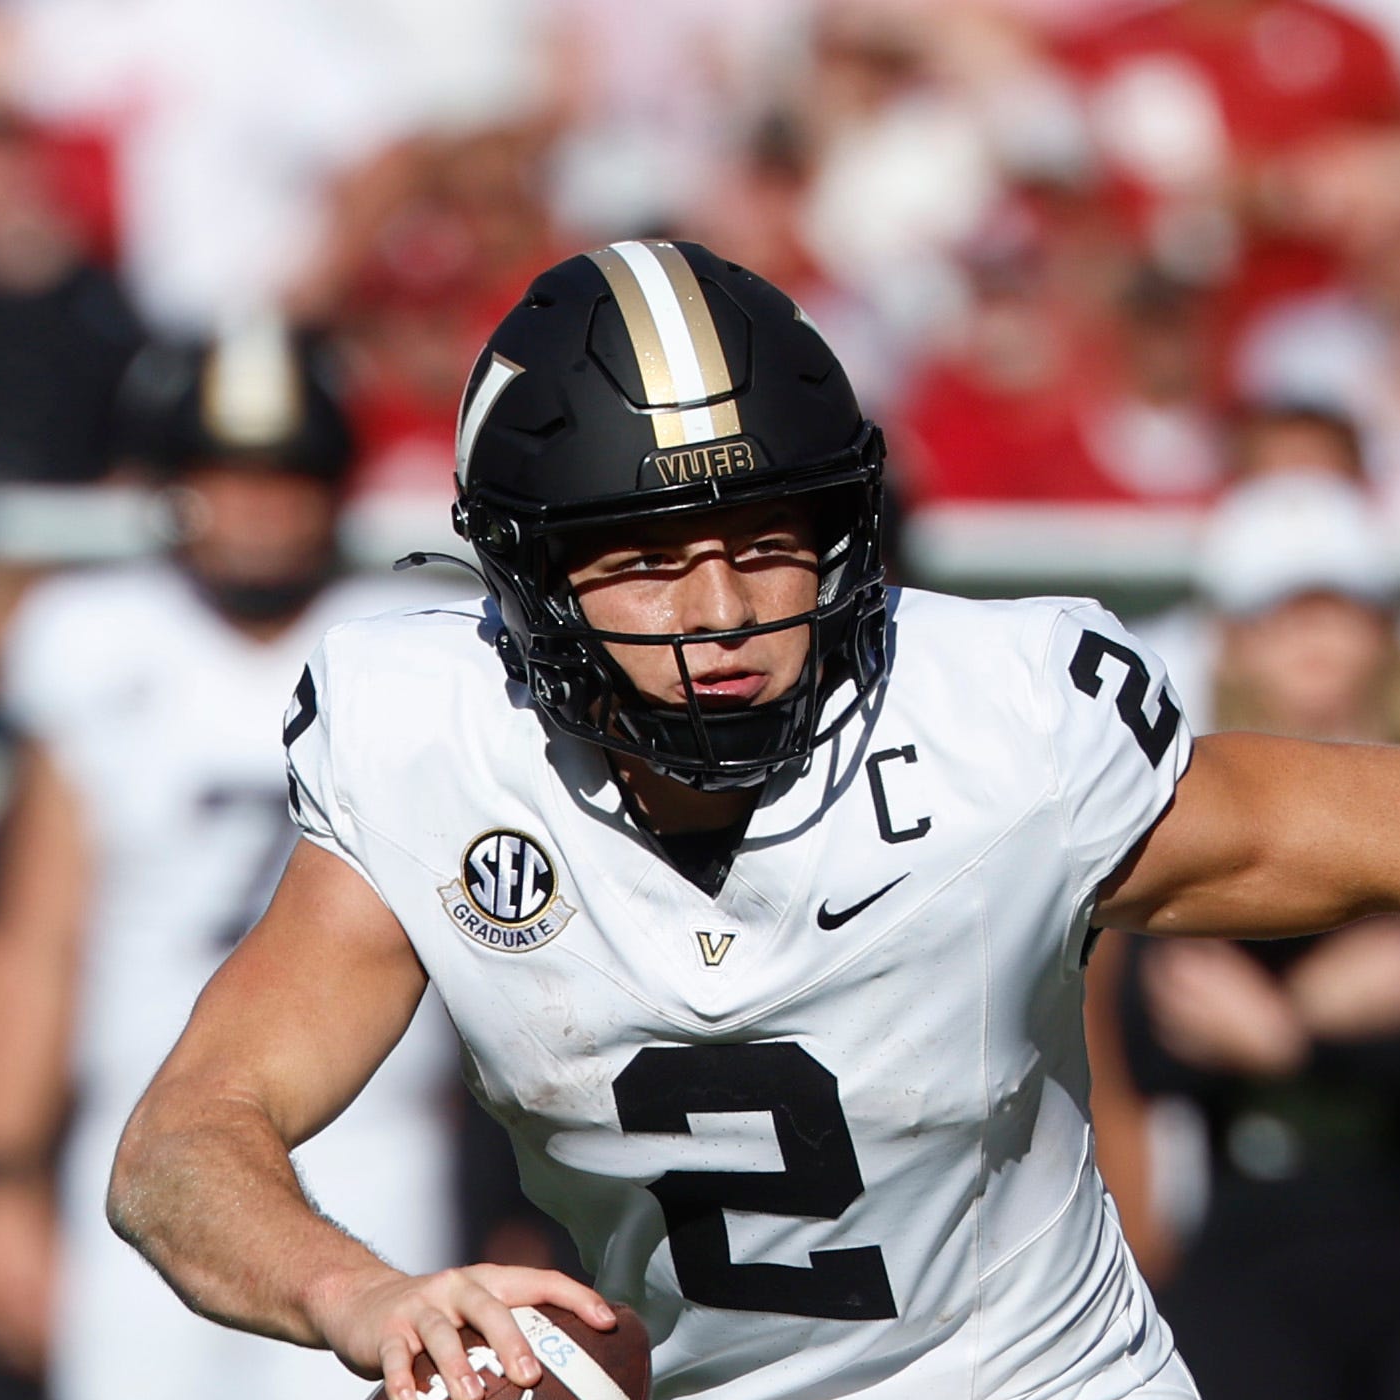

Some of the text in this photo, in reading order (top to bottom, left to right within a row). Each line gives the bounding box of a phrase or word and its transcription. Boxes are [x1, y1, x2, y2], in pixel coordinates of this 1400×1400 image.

[655, 441, 754, 486] VUFB
[1067, 628, 1181, 771] 2
[865, 744, 932, 845] C
[468, 834, 549, 920] SEC
[452, 903, 555, 948] GRADUATE
[694, 930, 737, 967] V
[612, 1040, 899, 1321] 2
